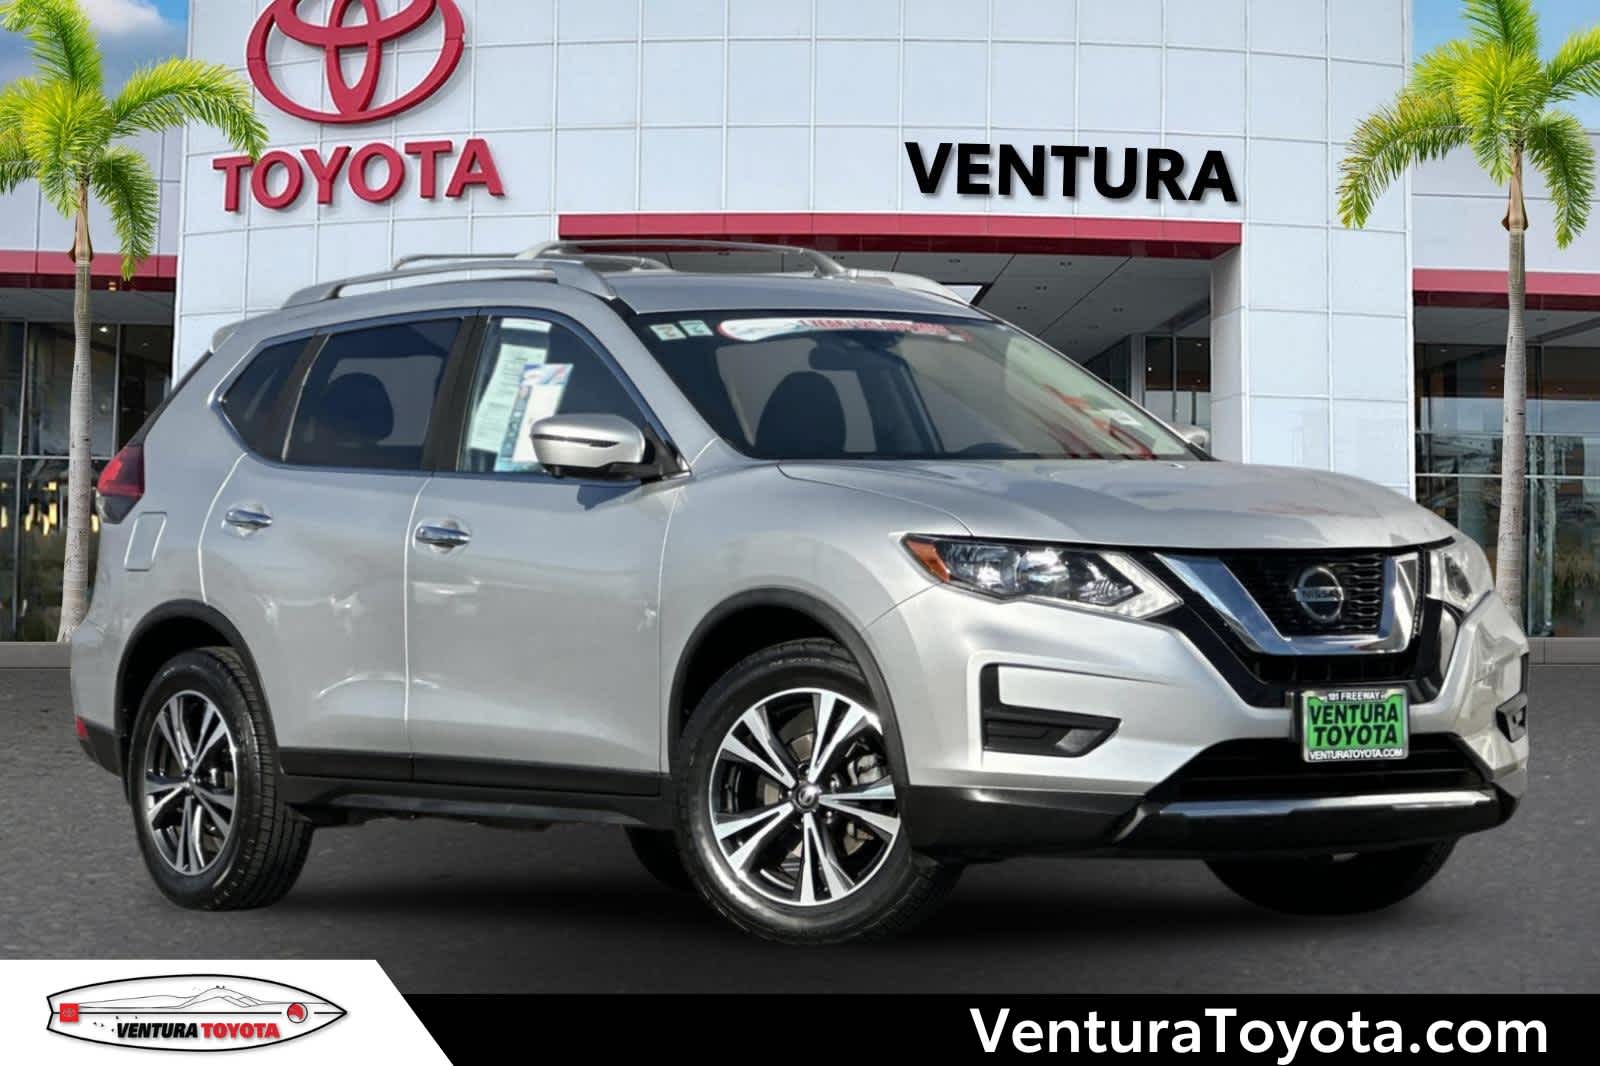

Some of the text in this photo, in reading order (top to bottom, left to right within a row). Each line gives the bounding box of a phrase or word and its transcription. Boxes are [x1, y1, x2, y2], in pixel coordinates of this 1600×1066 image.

[213, 138, 504, 212] TOYOTA
[905, 142, 1238, 203] VENTURA
[1341, 691, 1380, 701] FREEWAY
[1309, 703, 1399, 725] VENTURA
[1313, 724, 1398, 747] TOYOTA
[1308, 749, 1404, 761] VENTURATOYOTA.COM
